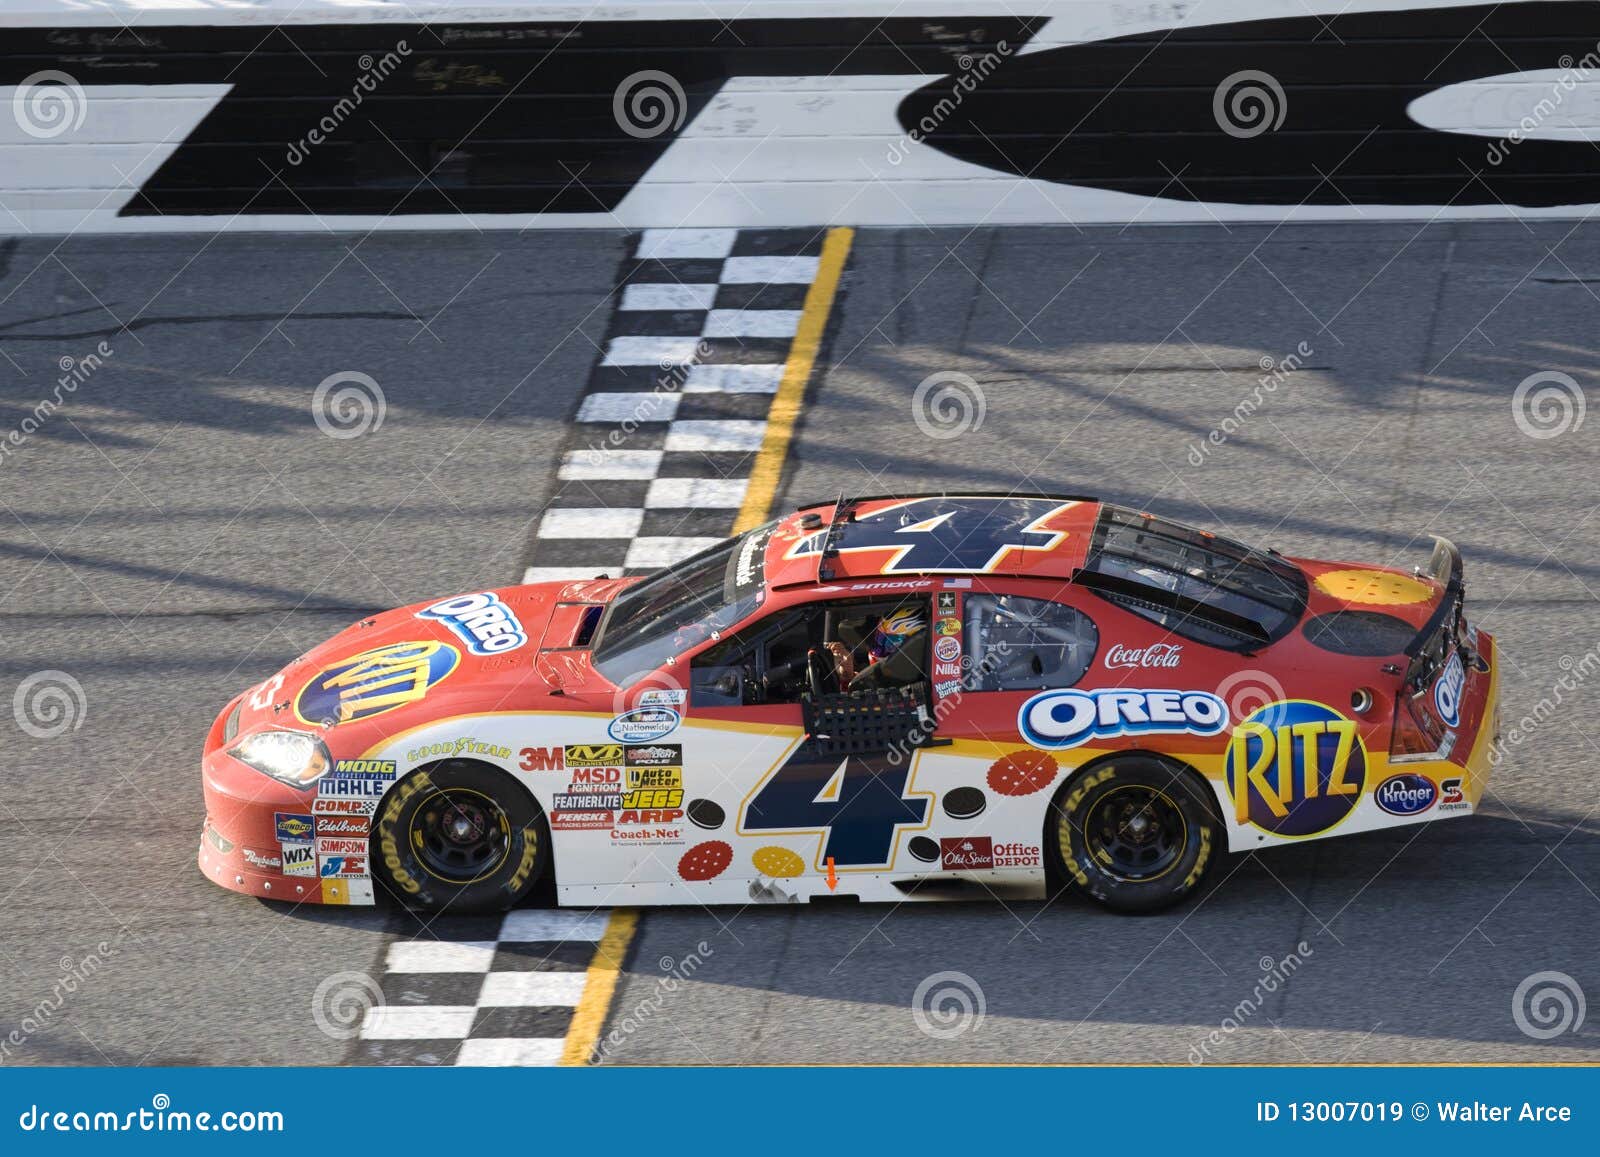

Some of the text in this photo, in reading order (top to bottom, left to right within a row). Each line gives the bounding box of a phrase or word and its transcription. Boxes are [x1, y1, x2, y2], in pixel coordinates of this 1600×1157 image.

[427, 595, 521, 653] OREO
[939, 646, 958, 656] KING
[935, 664, 960, 675] Nilla
[321, 640, 441, 721] RITZ
[1030, 693, 1222, 738] OREO
[408, 737, 512, 762] GOODYEAR
[336, 760, 396, 773] MOOG
[519, 747, 565, 771] 3M
[571, 768, 620, 784] MSD
[642, 769, 673, 778] Auto
[1232, 720, 1358, 825] RITZ
[319, 780, 383, 796] MAHLE
[571, 783, 618, 793] IGNITION
[641, 777, 680, 786] Meter
[554, 795, 620, 809] FEATHERLITE
[623, 789, 684, 809] JEGS
[1383, 780, 1432, 809] Kroger
[314, 800, 363, 812] COMP
[736, 732, 937, 873] 4
[556, 813, 608, 822] PENSKE
[617, 809, 684, 824] ARP
[278, 821, 313, 832] SUNOCO
[317, 818, 369, 834] Edelbrock
[611, 828, 681, 839] Coach-Net
[321, 839, 366, 854] SIMPSON
[993, 842, 1040, 857] Office
[283, 846, 314, 865] WIX
[944, 850, 992, 866] Old Spice
[994, 857, 1040, 867] DEPOT
[321, 857, 365, 877] JE
